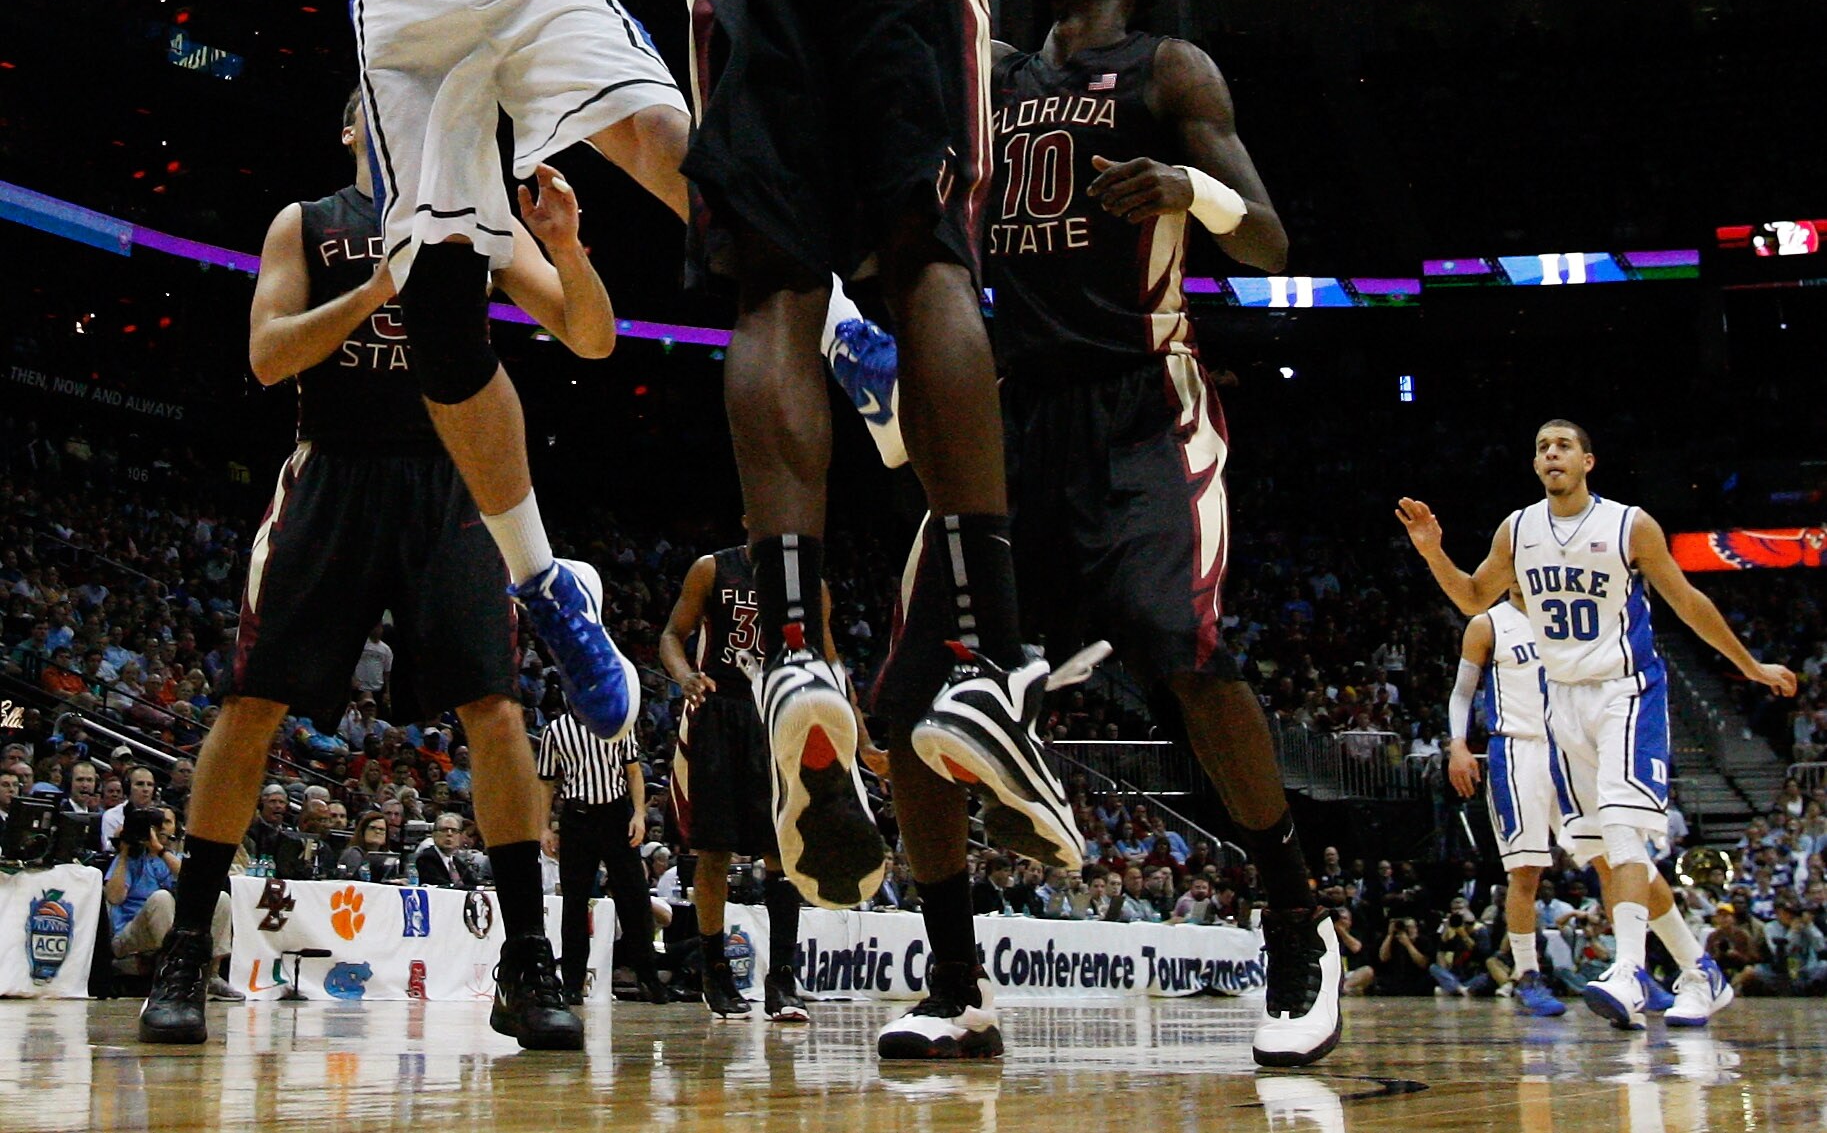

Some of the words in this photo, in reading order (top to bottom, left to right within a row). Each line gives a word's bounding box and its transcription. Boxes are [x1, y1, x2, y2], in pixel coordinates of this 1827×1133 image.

[1002, 129, 1074, 220] 10
[990, 218, 1089, 255] STATE
[340, 340, 411, 370] STA
[53, 376, 88, 398] NOW
[91, 386, 122, 407] AND
[125, 395, 185, 421] ALWAYS
[127, 467, 150, 483] 106
[1525, 566, 1610, 598] DUKE
[1541, 599, 1600, 641] 30
[35, 937, 67, 953] ACC
[796, 937, 893, 992] tlantic
[993, 937, 1135, 989] Conference
